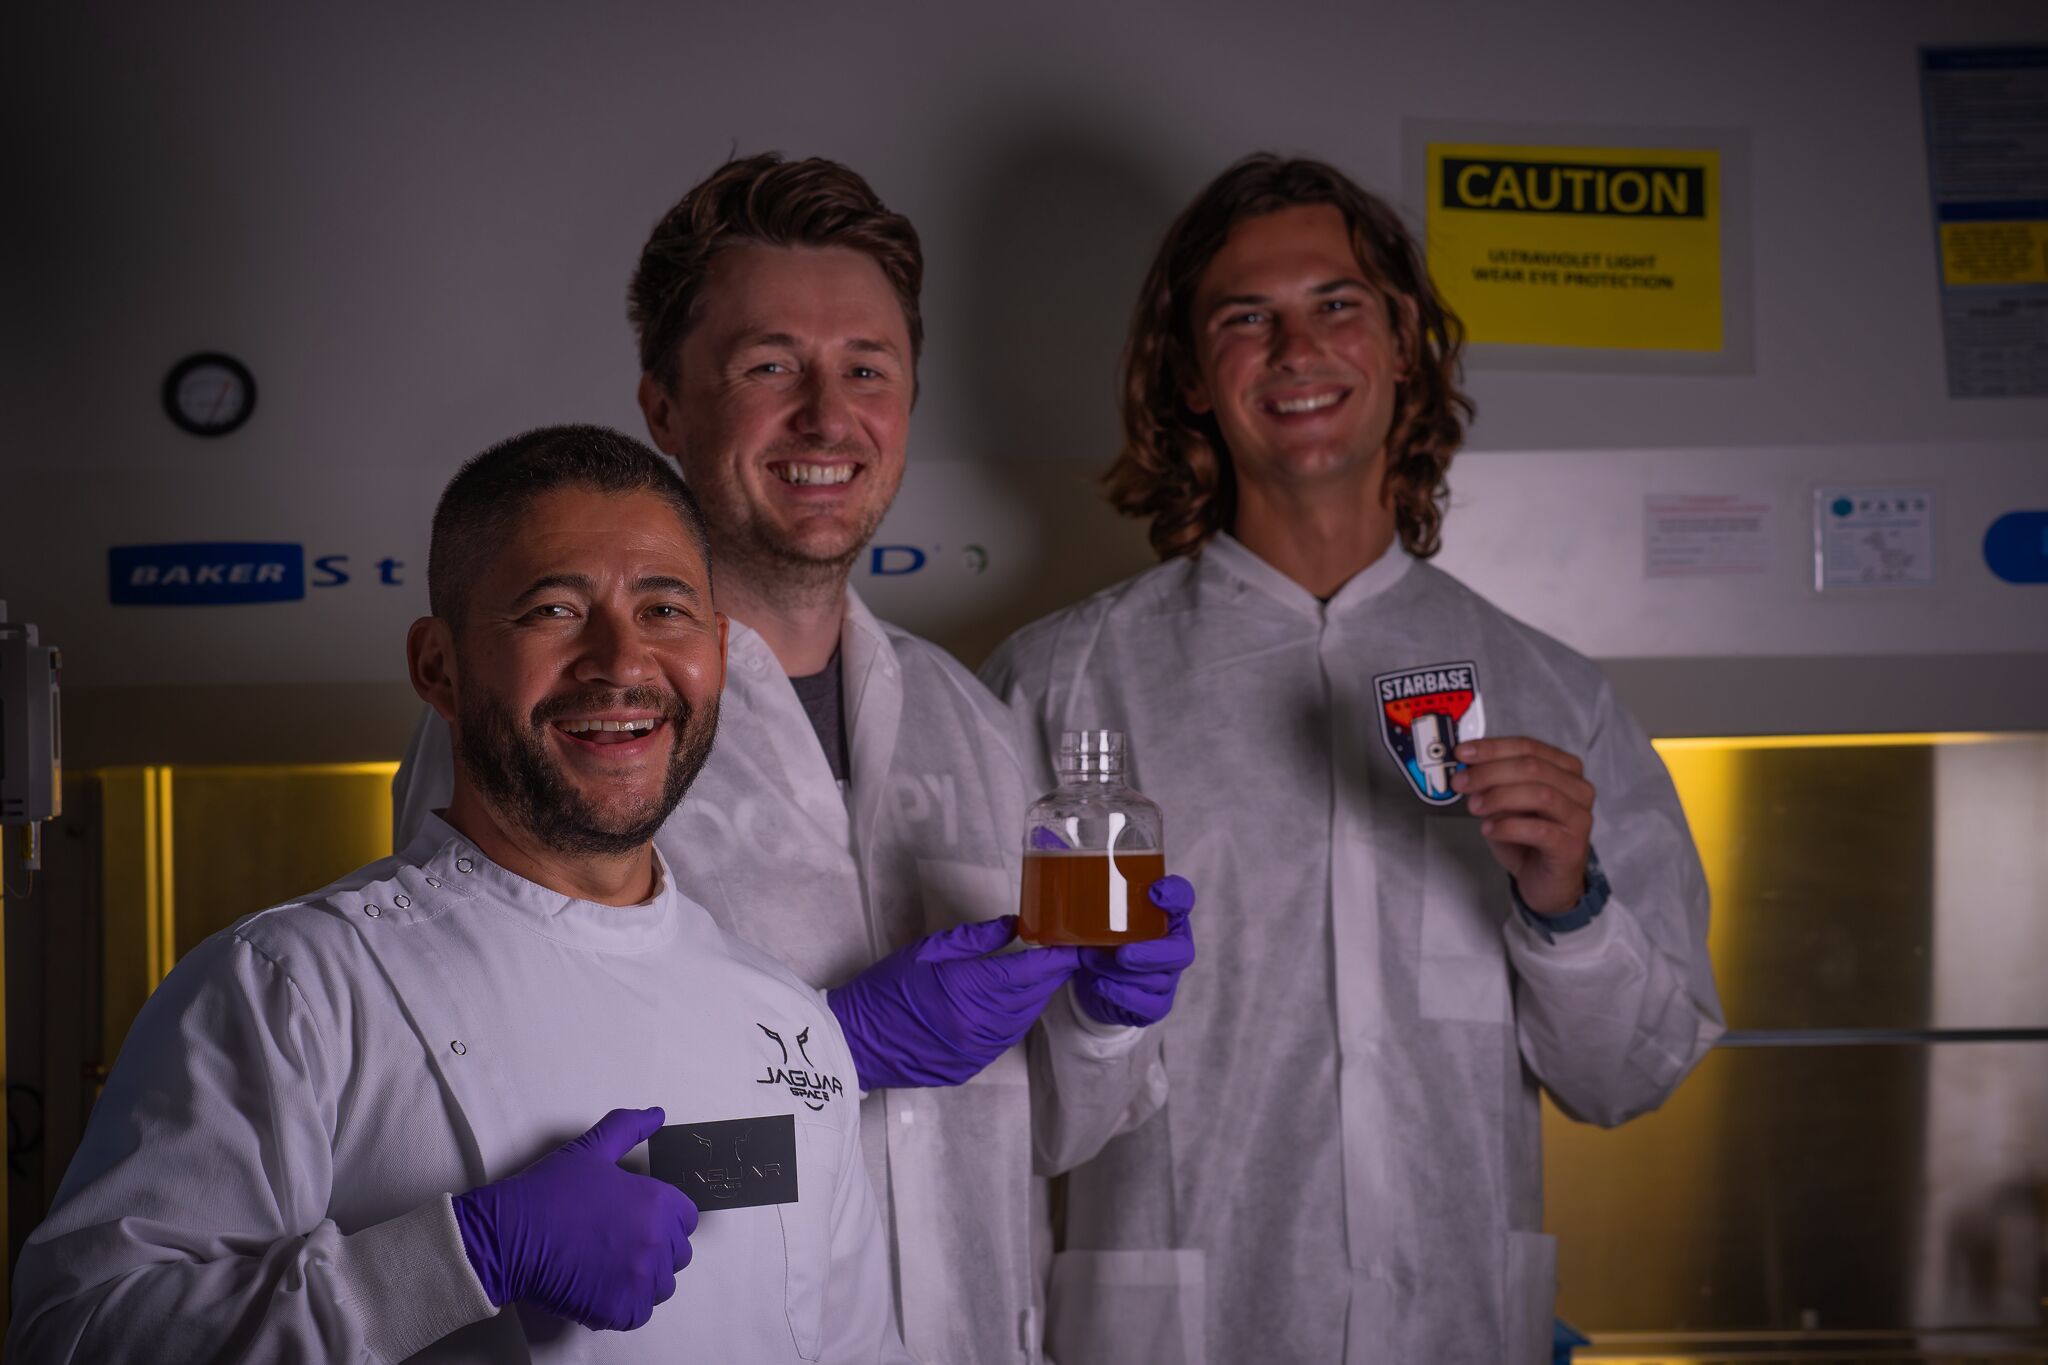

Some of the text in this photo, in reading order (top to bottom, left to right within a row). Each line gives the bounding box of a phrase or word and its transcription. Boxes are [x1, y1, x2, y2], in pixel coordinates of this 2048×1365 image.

[1455, 163, 1689, 215] CAUTION
[1487, 248, 1657, 270] ULTRAVIOLET LIGHT
[1472, 267, 1675, 291] WEAR EYE PROTECTION
[128, 561, 287, 587] BAKER
[1381, 669, 1472, 701] STARBASE
[756, 1066, 843, 1098] JAGUAR
[789, 1087, 830, 1102] SPACE
